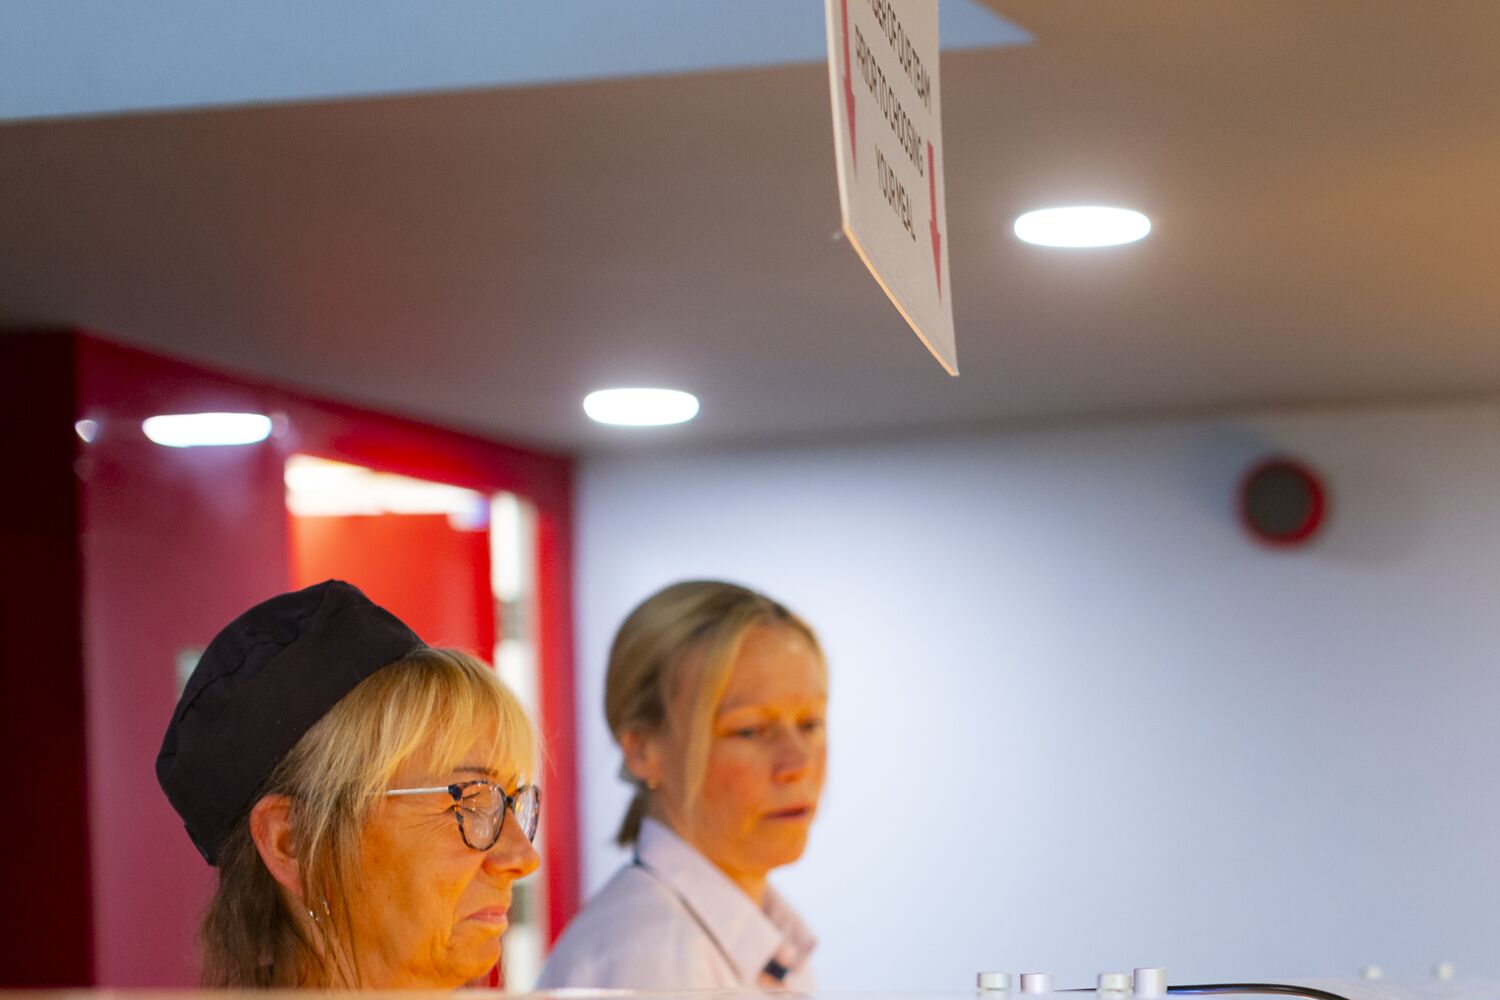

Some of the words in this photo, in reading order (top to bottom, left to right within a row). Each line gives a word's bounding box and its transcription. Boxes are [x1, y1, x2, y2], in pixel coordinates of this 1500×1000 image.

[855, 23, 877, 104] PRIOR
[877, 63, 887, 120] TO
[888, 85, 923, 178] CHOOSING
[887, 1, 896, 52] OF
[898, 21, 912, 83] OUR
[912, 47, 931, 115] TEAM
[874, 143, 895, 212] YOUR
[895, 174, 916, 242] MEAL
